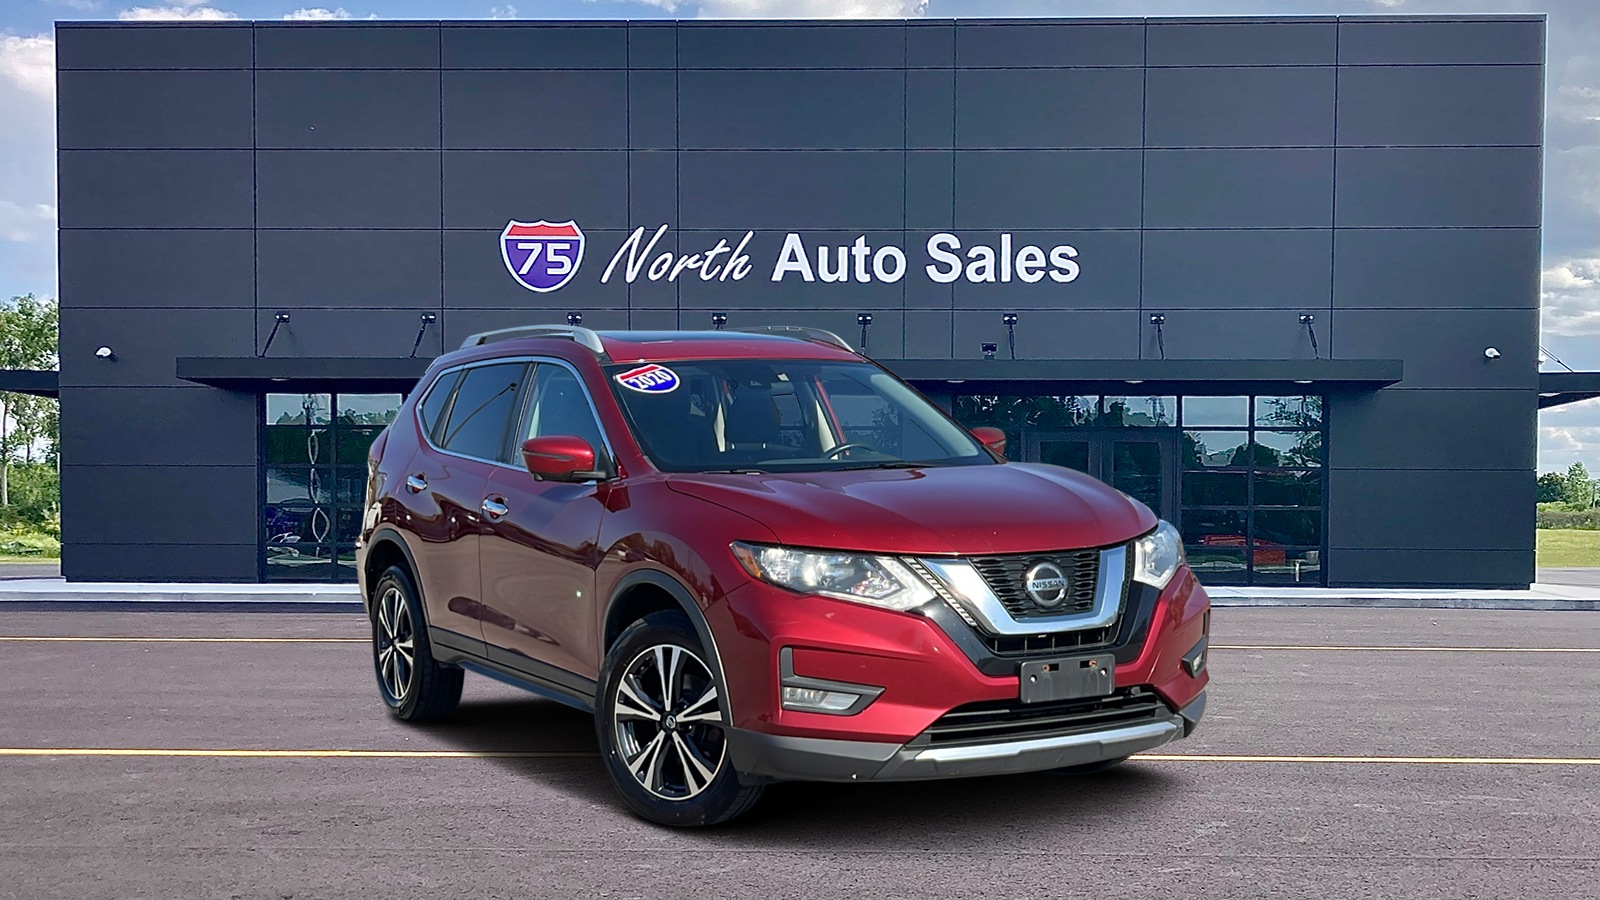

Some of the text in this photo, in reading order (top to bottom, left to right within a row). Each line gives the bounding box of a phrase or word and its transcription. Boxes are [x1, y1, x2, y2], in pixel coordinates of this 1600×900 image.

[516, 224, 1080, 284] 75 North Auto Sales
[628, 370, 673, 389] 2020
[1032, 579, 1065, 589] NISSAN
